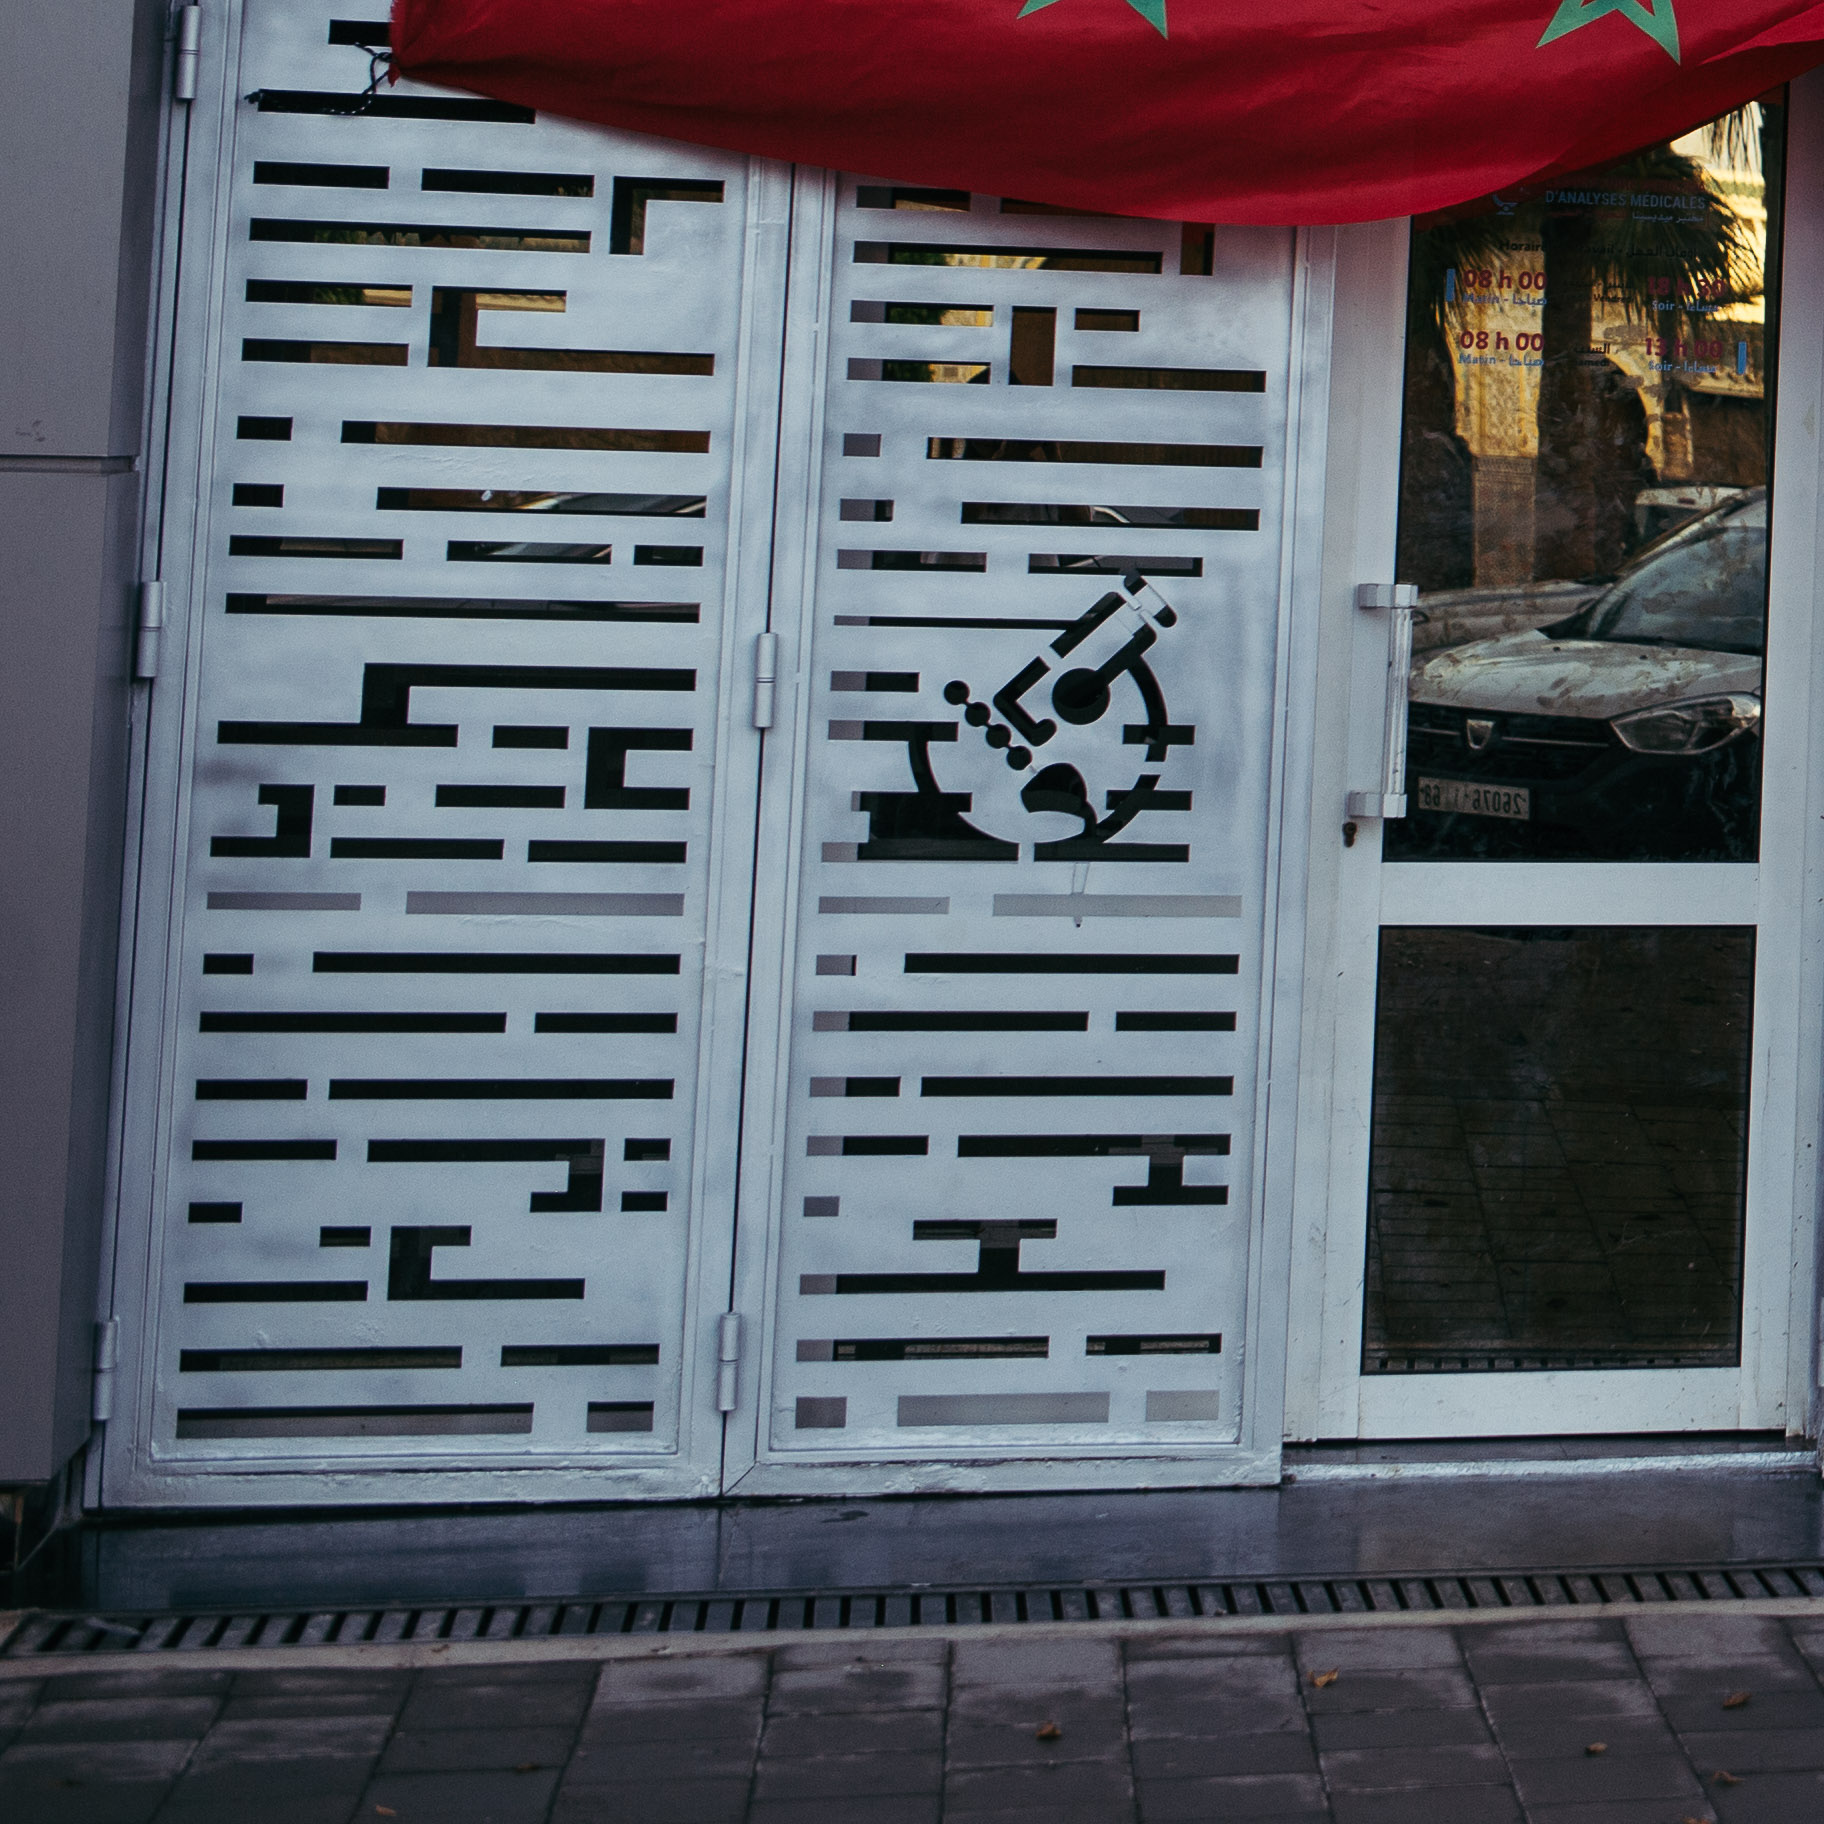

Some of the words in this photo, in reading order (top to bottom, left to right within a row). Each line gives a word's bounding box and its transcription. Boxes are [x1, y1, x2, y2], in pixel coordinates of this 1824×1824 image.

[1545, 190, 1627, 207] D'ANALYSES
[1630, 191, 1706, 210] MÉDICALES
[1464, 269, 1492, 288] 08
[1499, 269, 1512, 289] h
[1518, 271, 1548, 290] 00
[1652, 300, 1675, 311] Soir
[1460, 330, 1489, 350] 08
[1496, 331, 1509, 350] h
[1515, 332, 1545, 352] 00
[1645, 336, 1667, 356] 13
[1674, 337, 1687, 357] h
[1694, 339, 1722, 358] 00
[1458, 352, 1496, 365] Matin
[1570, 357, 1610, 367] amedi
